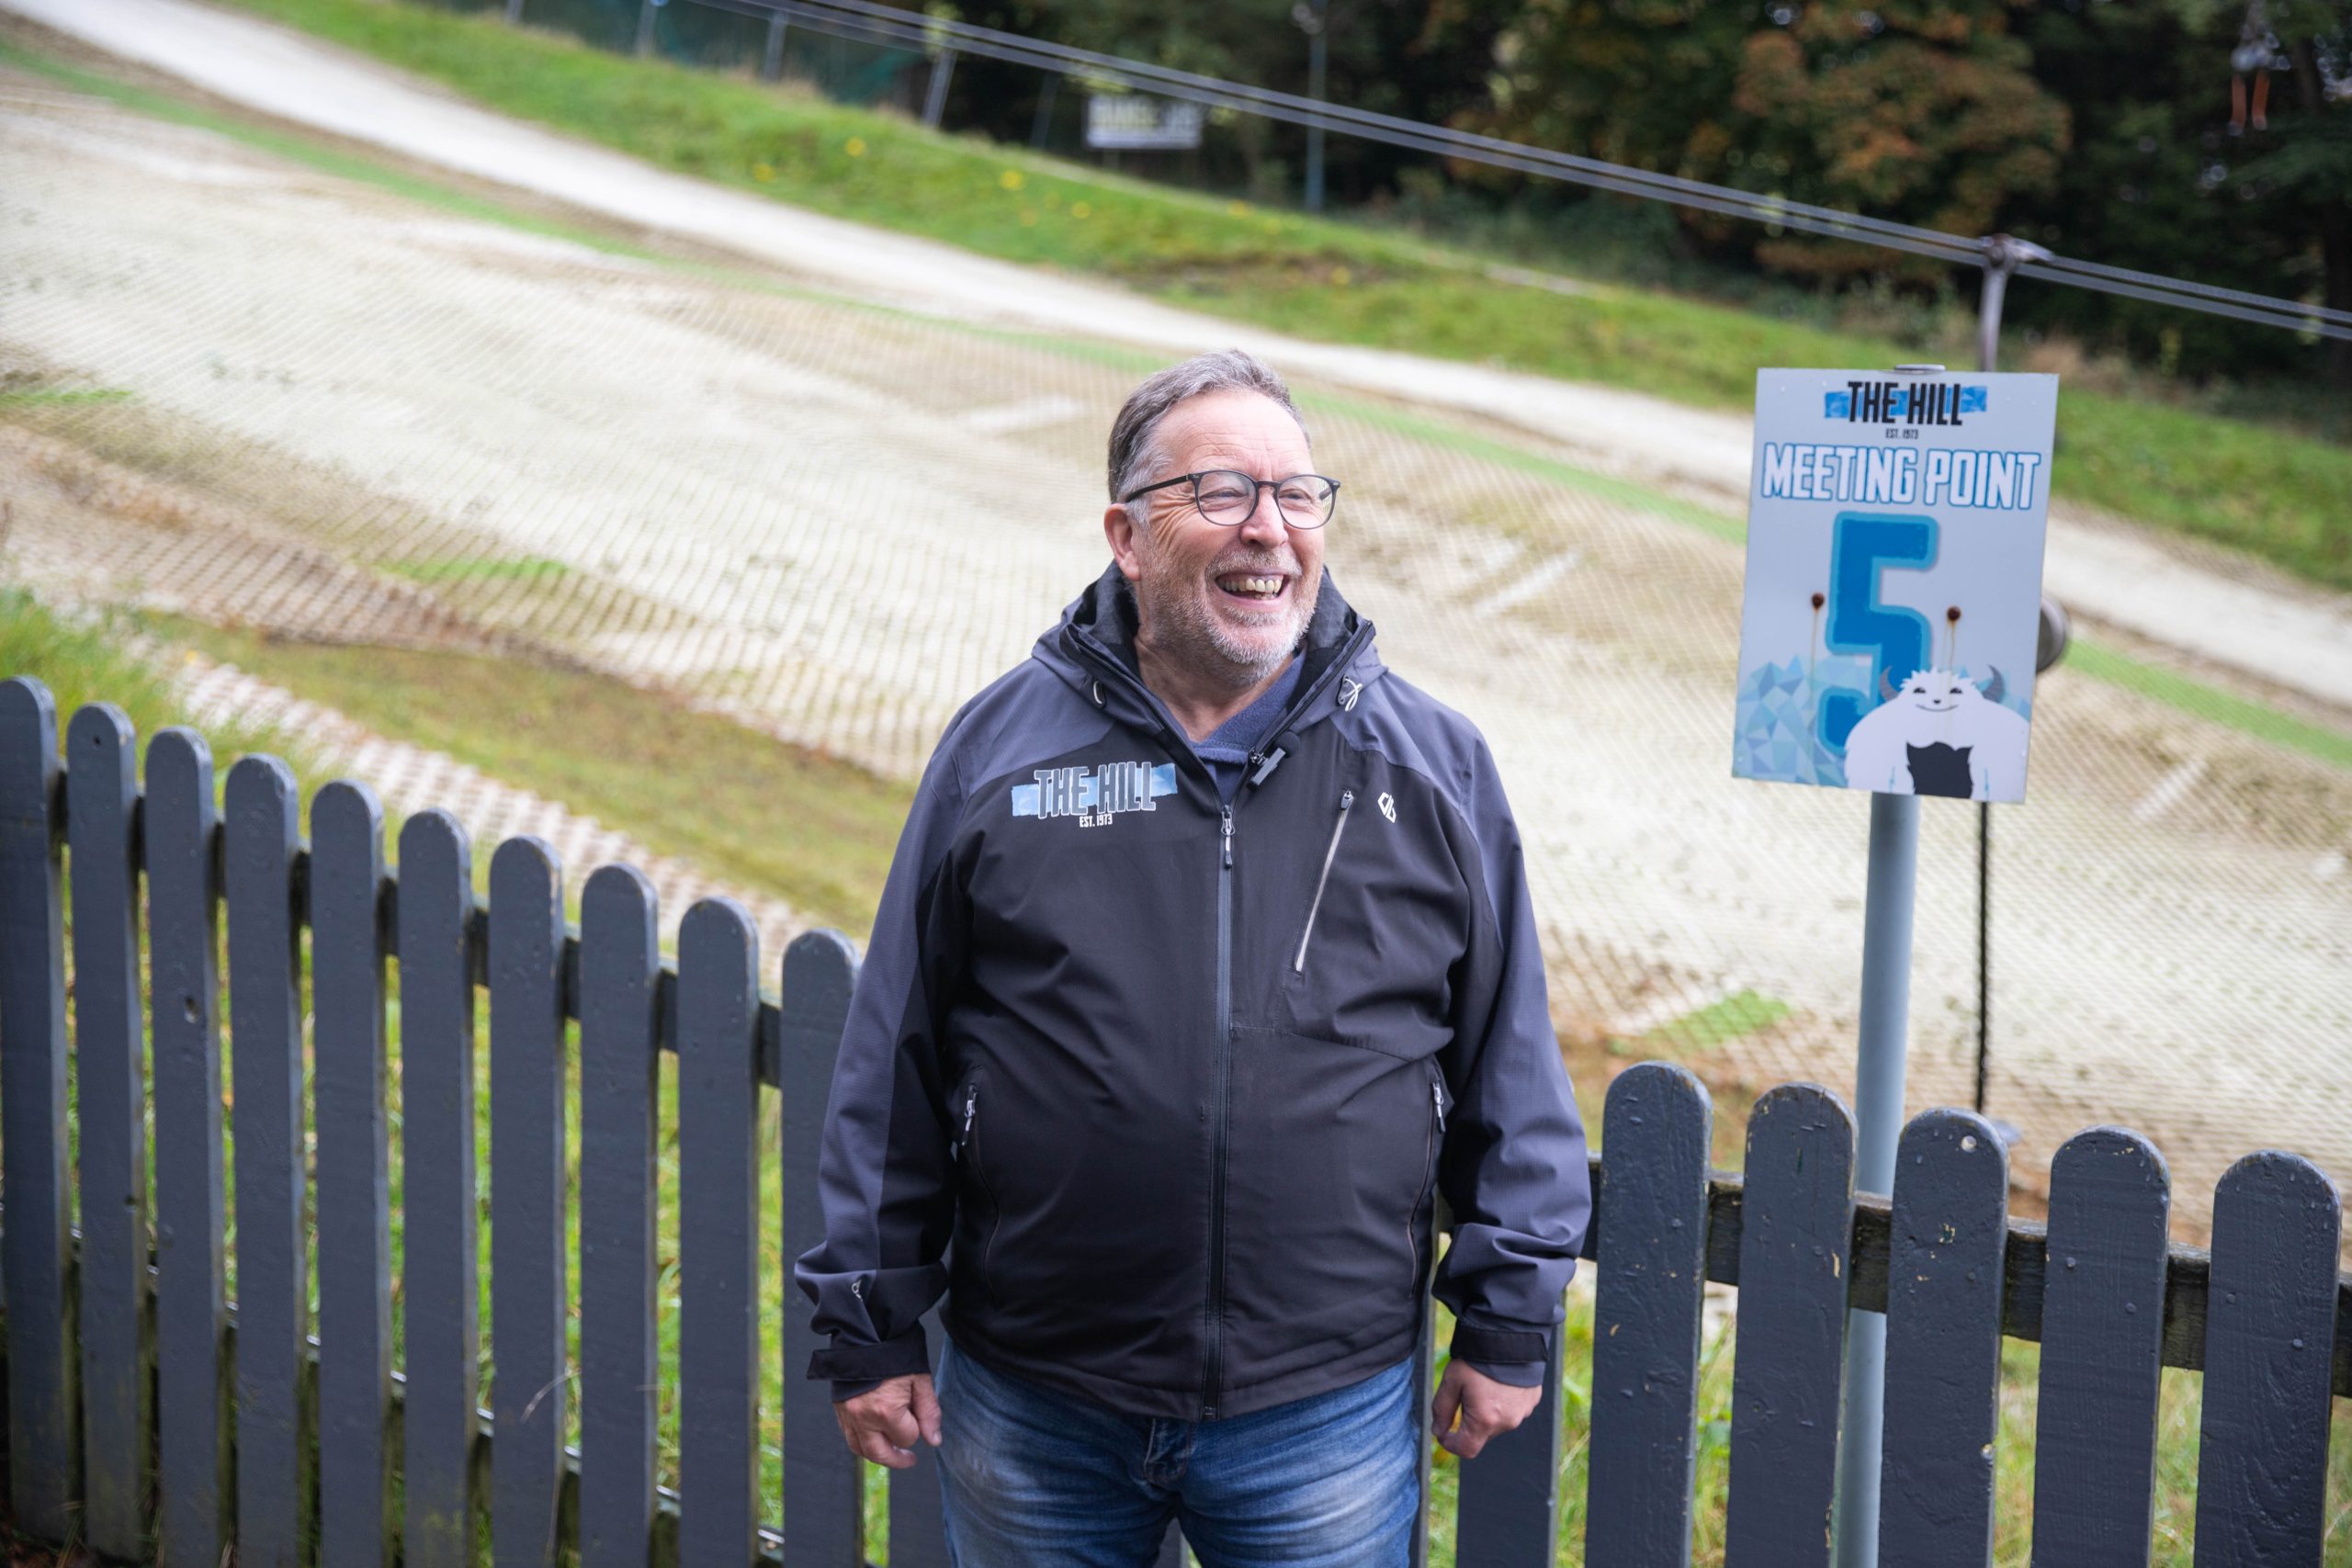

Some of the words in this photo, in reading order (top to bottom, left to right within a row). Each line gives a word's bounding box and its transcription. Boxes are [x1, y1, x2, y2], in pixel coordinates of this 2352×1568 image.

[1849, 381, 1898, 423] THE
[1907, 383, 1962, 425] HILL
[1886, 428, 1901, 439] EST.
[1761, 443, 1917, 503] MEETING
[1925, 449, 2041, 510] POINT
[1817, 511, 1939, 756] 5
[1034, 766, 1089, 819] THE
[1097, 761, 1156, 814] HILL
[1080, 816, 1095, 827] EST.
[1097, 814, 1113, 826] 1973
